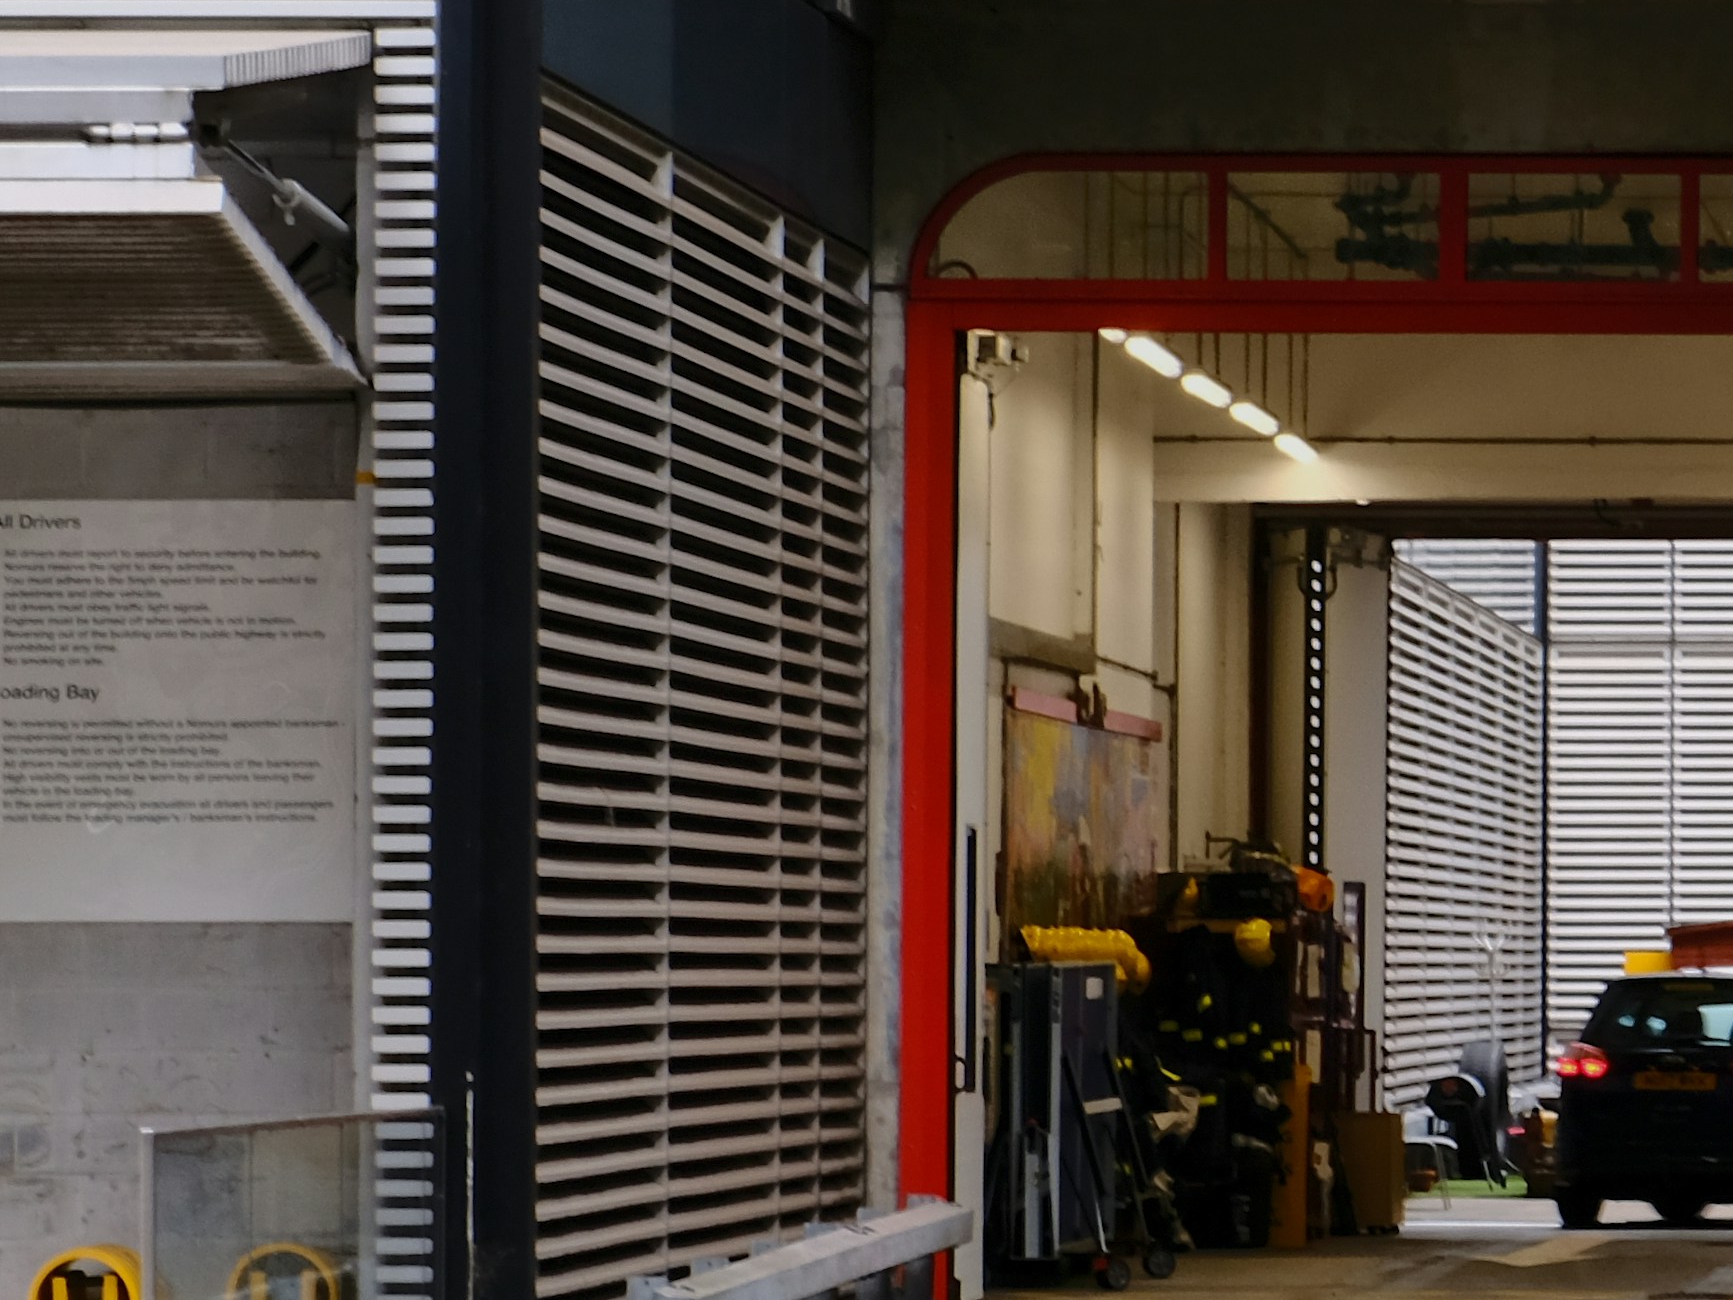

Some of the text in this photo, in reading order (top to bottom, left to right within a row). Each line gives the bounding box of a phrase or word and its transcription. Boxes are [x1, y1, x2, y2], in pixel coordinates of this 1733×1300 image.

[19, 514, 82, 529] Drivers
[0, 685, 100, 704] oading Bay
